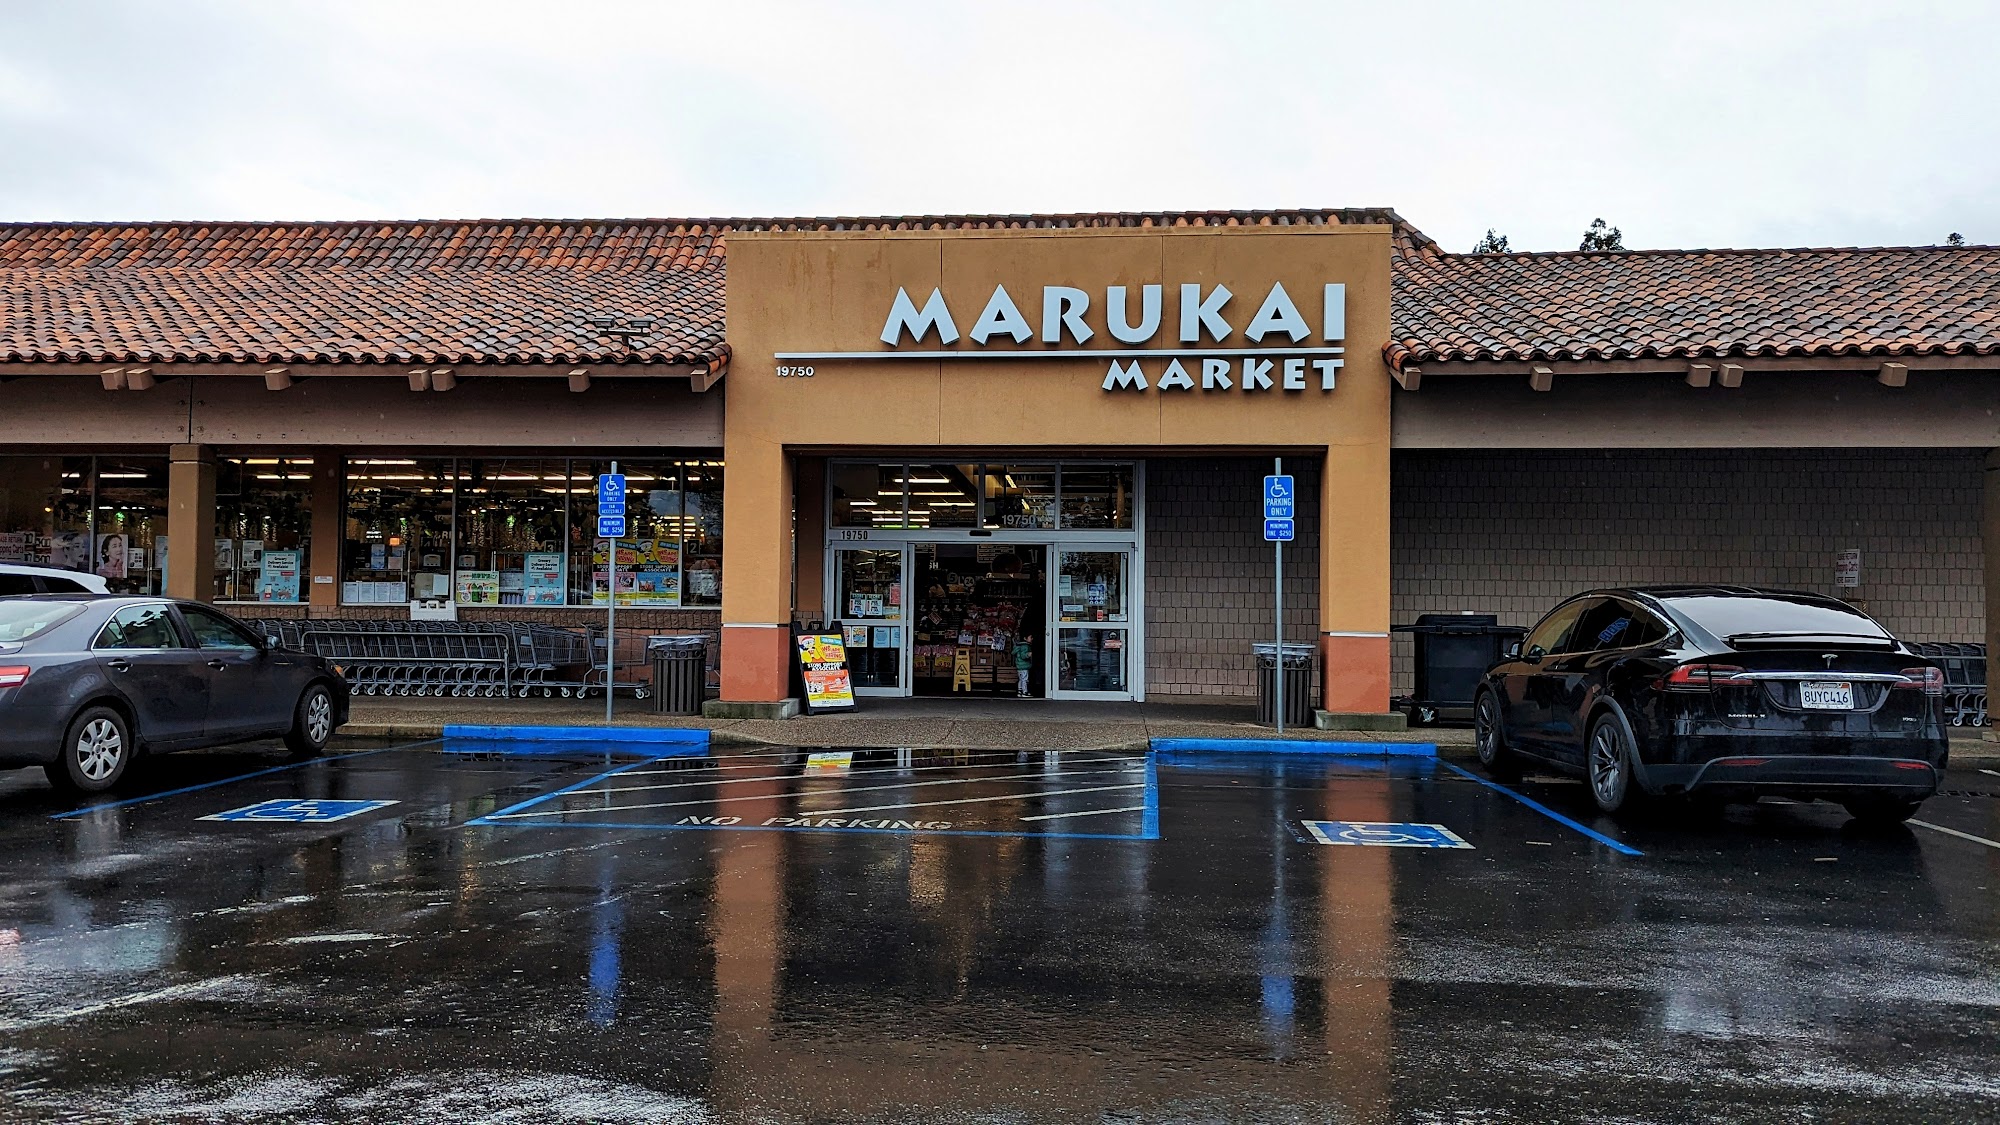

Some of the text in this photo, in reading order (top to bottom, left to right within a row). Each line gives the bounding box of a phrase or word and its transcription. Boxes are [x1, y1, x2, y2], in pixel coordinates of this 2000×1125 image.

[880, 281, 1345, 347] MARUKAI
[775, 366, 814, 376] 19750
[1101, 357, 1345, 391] MARKET
[1266, 498, 1292, 506] PARKING
[1271, 507, 1287, 516] ONLY
[1001, 514, 1036, 525] 19750
[841, 530, 869, 540] 19750
[690, 543, 697, 553] 2
[1804, 691, 1849, 703] 8UYC416
[677, 815, 953, 831] NO PARKING
